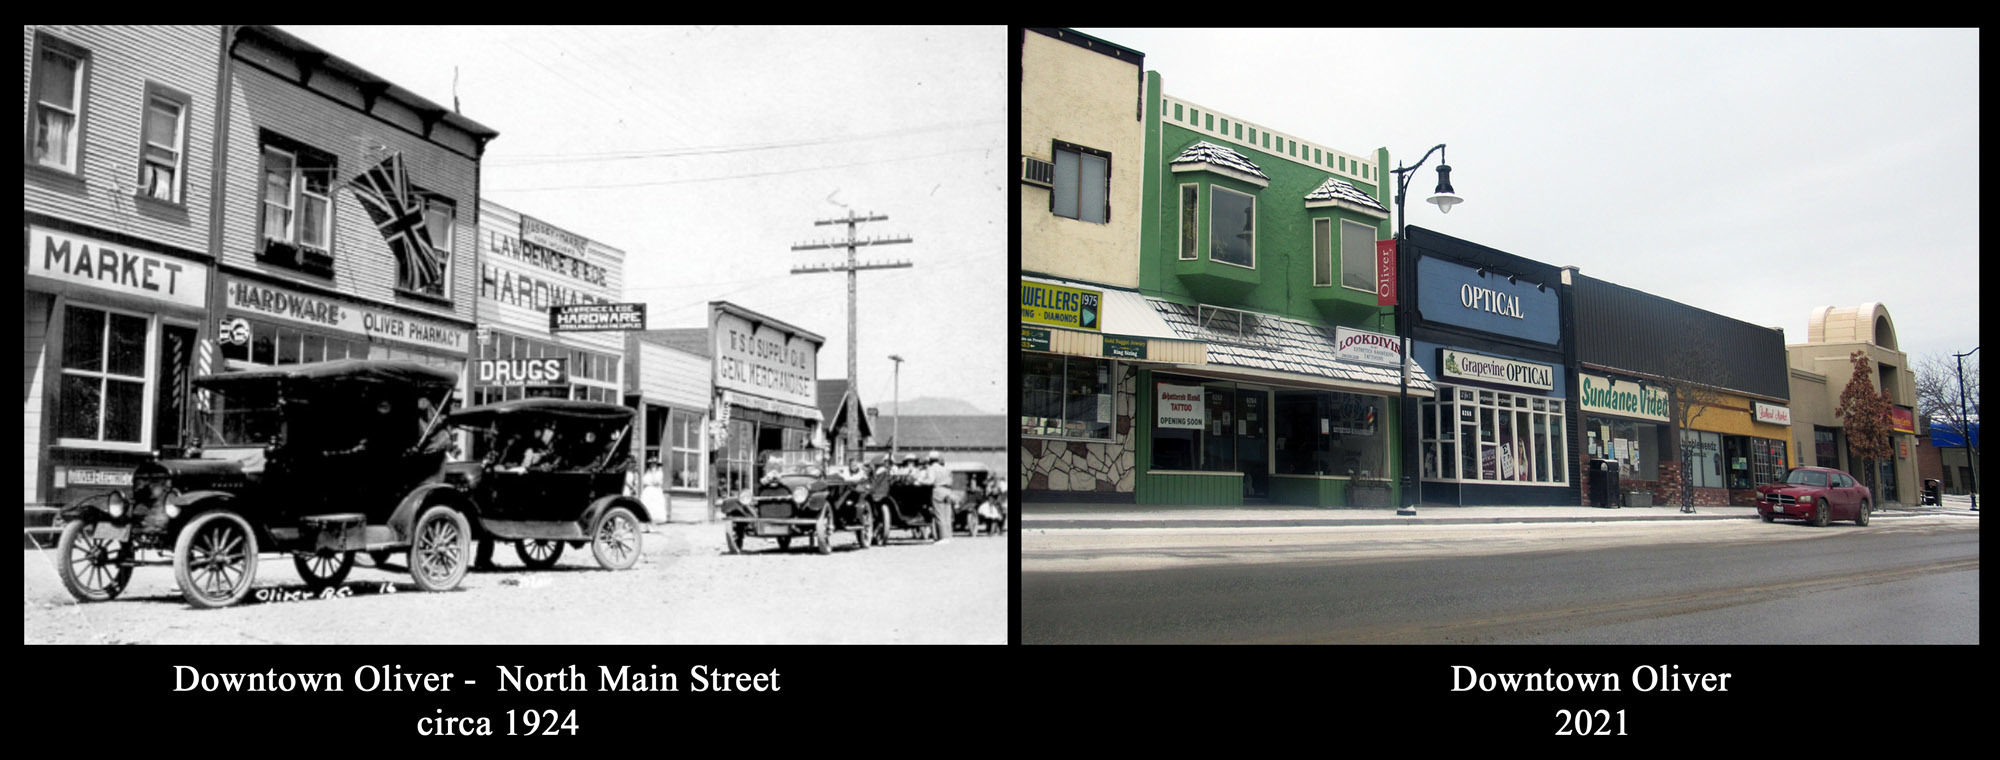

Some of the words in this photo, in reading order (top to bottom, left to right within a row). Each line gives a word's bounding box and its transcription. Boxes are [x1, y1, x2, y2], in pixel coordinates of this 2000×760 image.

[44, 237, 183, 295] MARKET
[1380, 249, 1390, 298] Oliver
[1022, 286, 1079, 312] WELLERS
[1082, 294, 1098, 307] 1975
[1461, 283, 1524, 319] OPTICAL
[236, 283, 340, 327] HARDWARE
[364, 312, 406, 340] OLIVER
[409, 322, 461, 351] PHARMACY
[557, 312, 642, 324] HARDWARE
[1044, 312, 1078, 324] DIAMONDS
[1339, 334, 1402, 356] LOOKDIVIN
[480, 359, 560, 381] DRUGS
[1462, 357, 1505, 377] Grapevine
[1506, 363, 1552, 387] OPTICAL
[1170, 403, 1193, 412] TATTOO
[1582, 377, 1638, 413] Sundance
[1640, 386, 1668, 417] Video
[1160, 417, 1186, 426] OPENING
[1187, 418, 1203, 426] SOON
